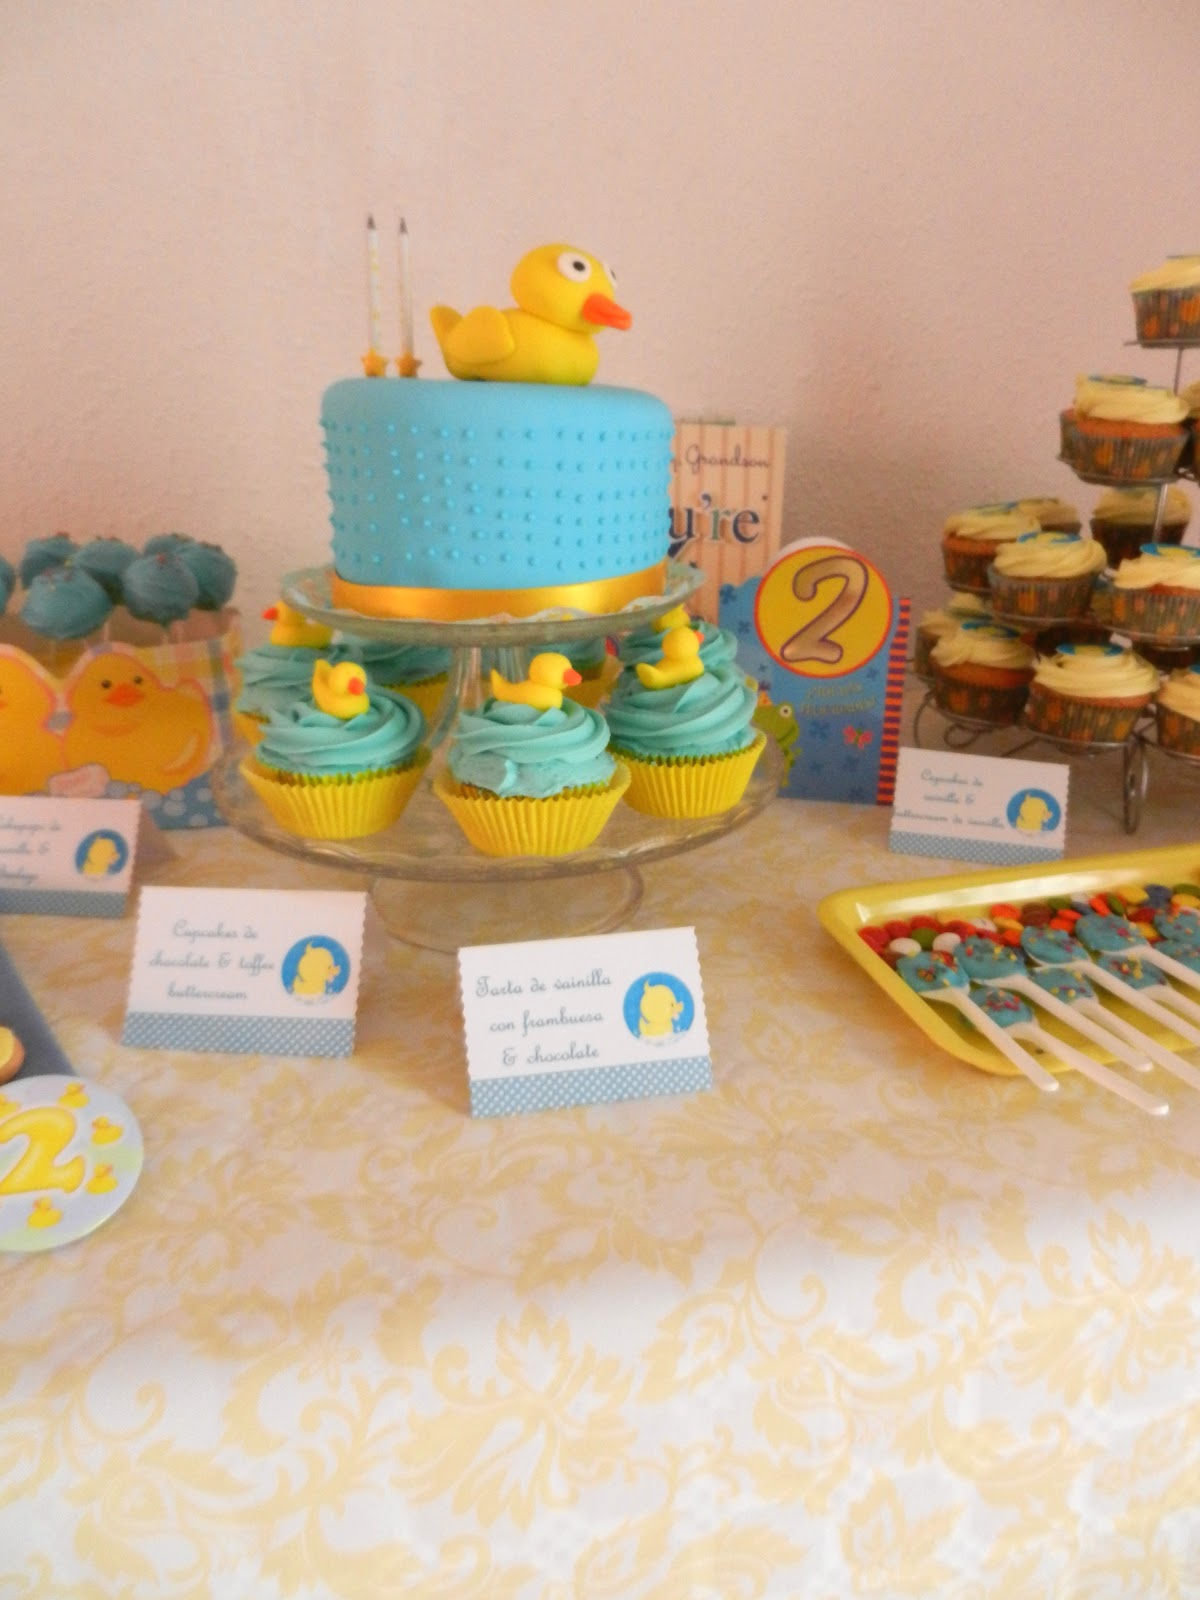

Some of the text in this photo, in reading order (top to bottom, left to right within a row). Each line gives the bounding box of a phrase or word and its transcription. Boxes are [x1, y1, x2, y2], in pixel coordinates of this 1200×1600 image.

[686, 443, 769, 474] Grandson
[668, 493, 760, 544] u're
[779, 554, 869, 664] 2
[172, 919, 259, 944] Cupcakes de
[148, 950, 275, 976] chocolate & toffee
[167, 982, 248, 1000] buttercream
[475, 968, 613, 998] Tarta de vainilla
[489, 1007, 604, 1038] con frambuesa
[502, 1041, 600, 1066] & chocolate
